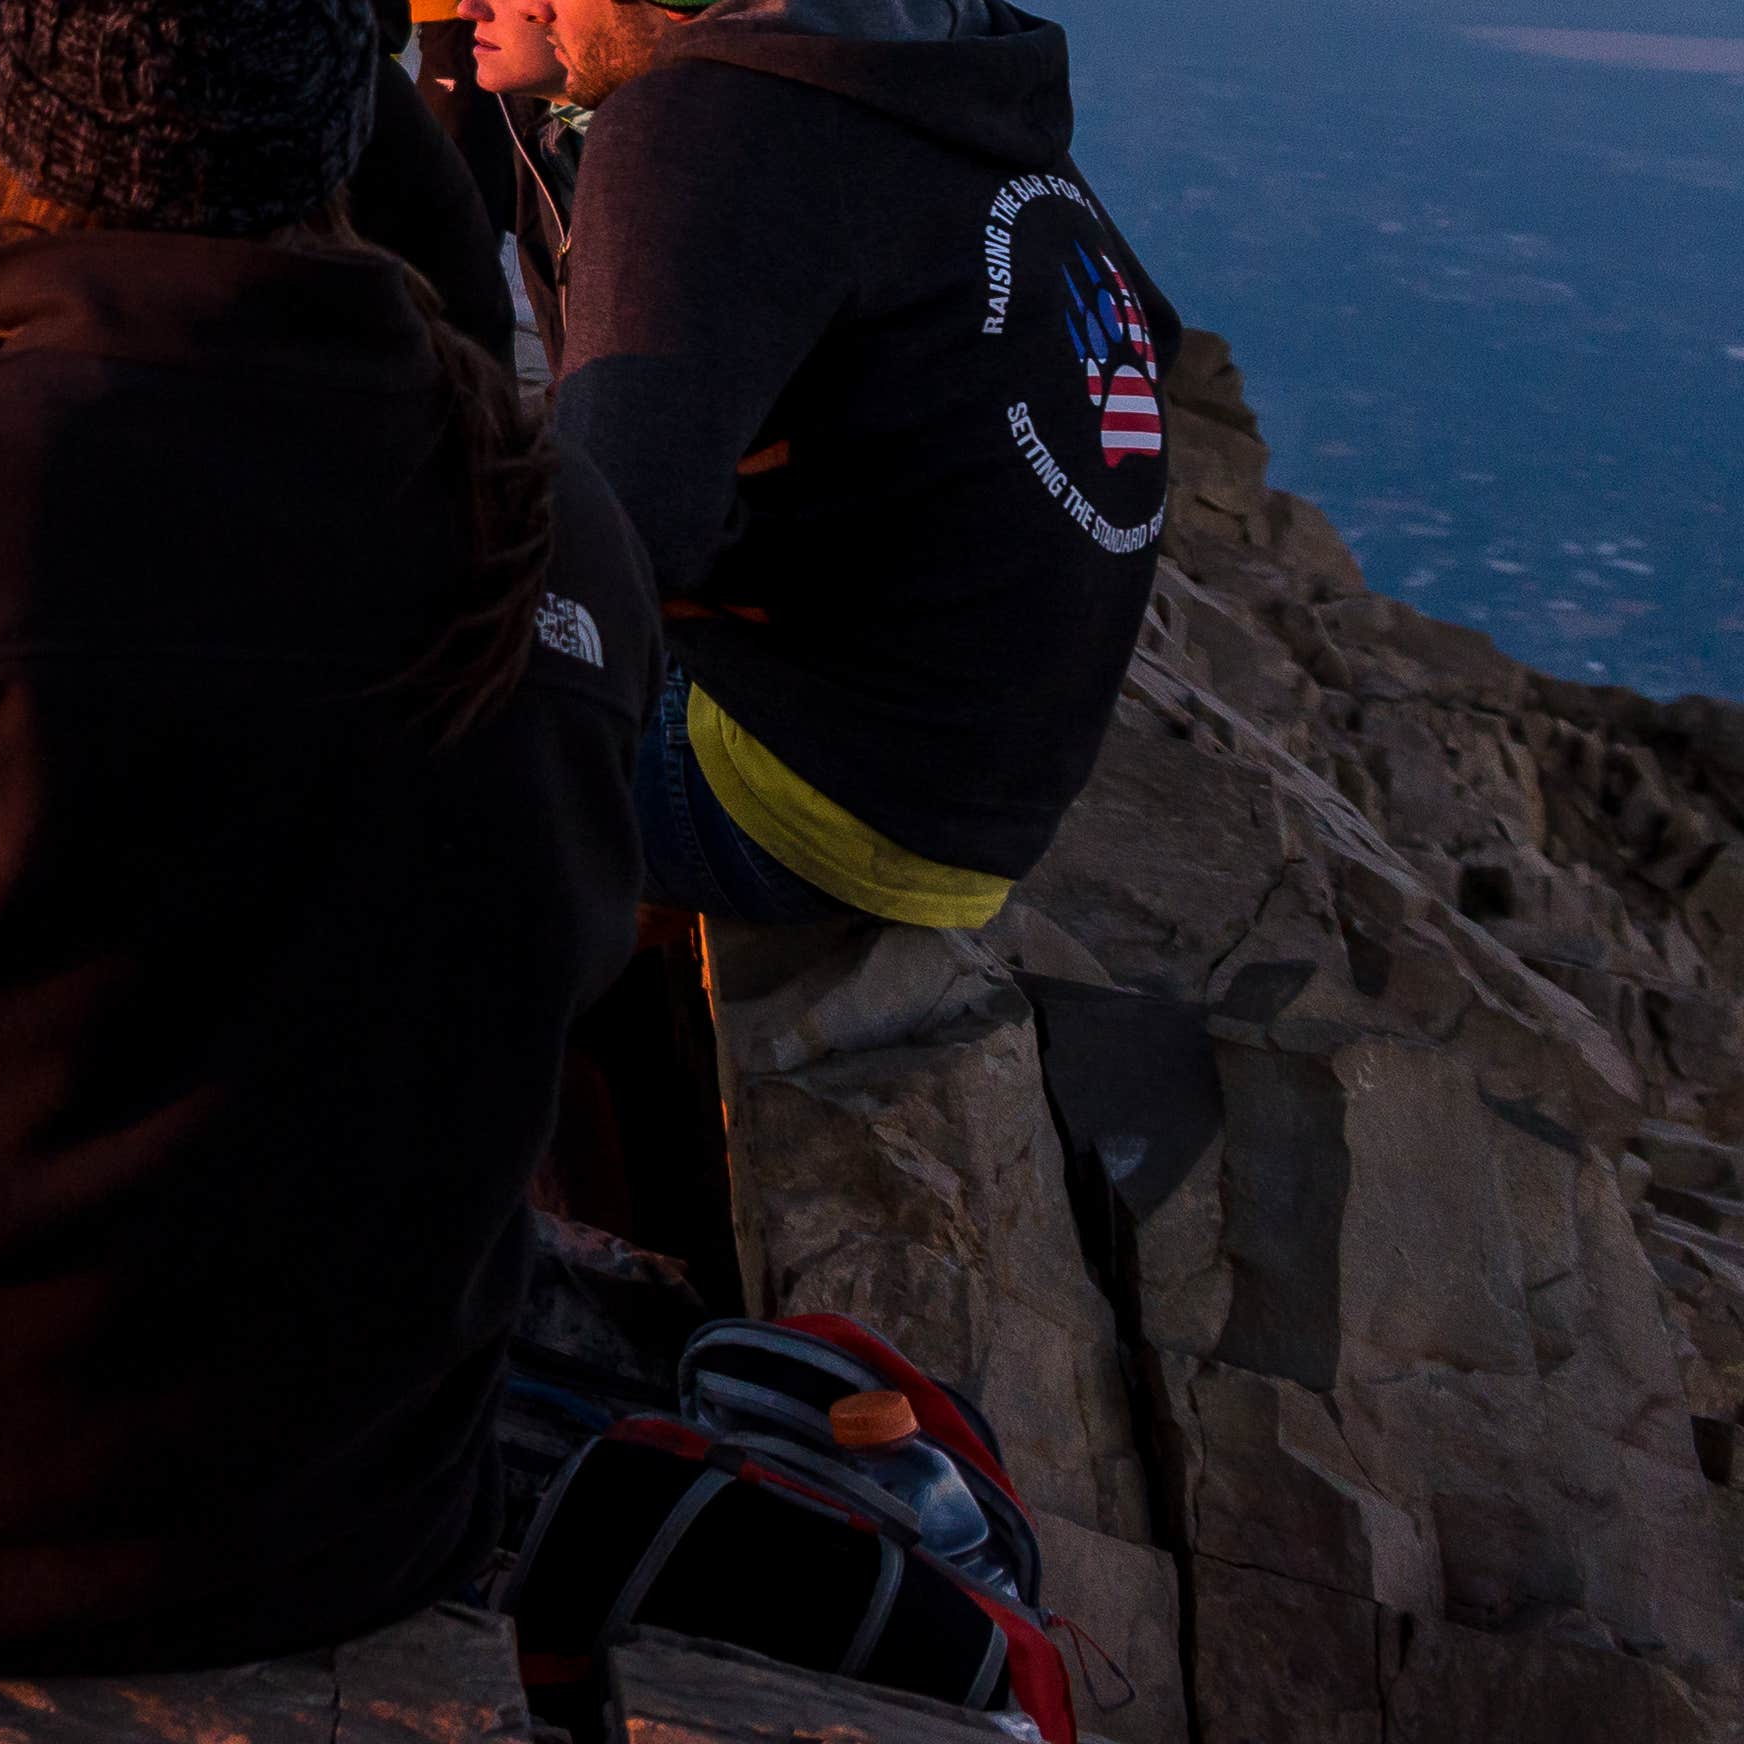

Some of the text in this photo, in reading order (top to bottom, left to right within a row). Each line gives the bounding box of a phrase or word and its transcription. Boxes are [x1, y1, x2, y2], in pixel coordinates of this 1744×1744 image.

[991, 187, 1023, 226] THE
[1009, 173, 1050, 206] BAR
[981, 224, 1011, 336] RAISING
[1007, 400, 1068, 498] SETTING
[1063, 485, 1095, 531] THE
[1092, 514, 1148, 555] STANDARD
[535, 607, 579, 640] ORTH
